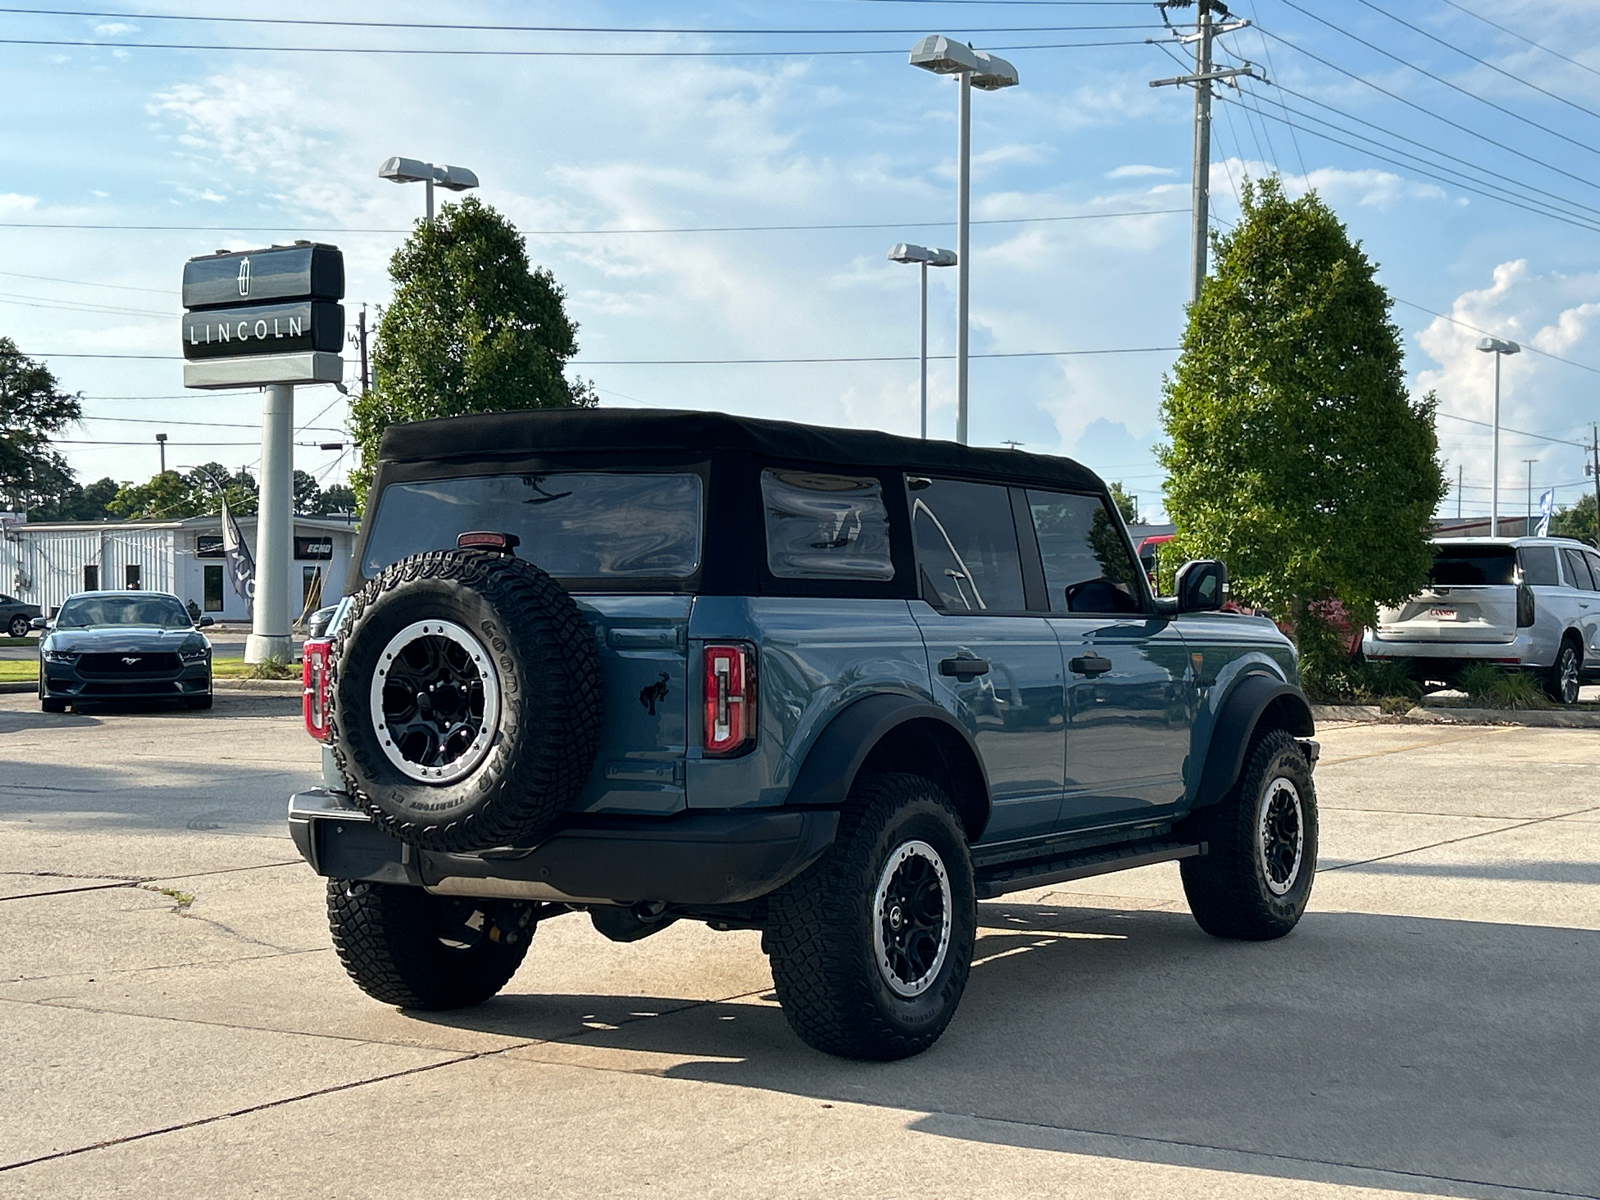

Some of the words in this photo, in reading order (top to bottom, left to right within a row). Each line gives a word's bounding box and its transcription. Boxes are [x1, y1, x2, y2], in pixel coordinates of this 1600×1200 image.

[190, 316, 302, 345] LINCOLN
[307, 544, 331, 553] ECHO
[479, 620, 522, 793] GOODYEAR
